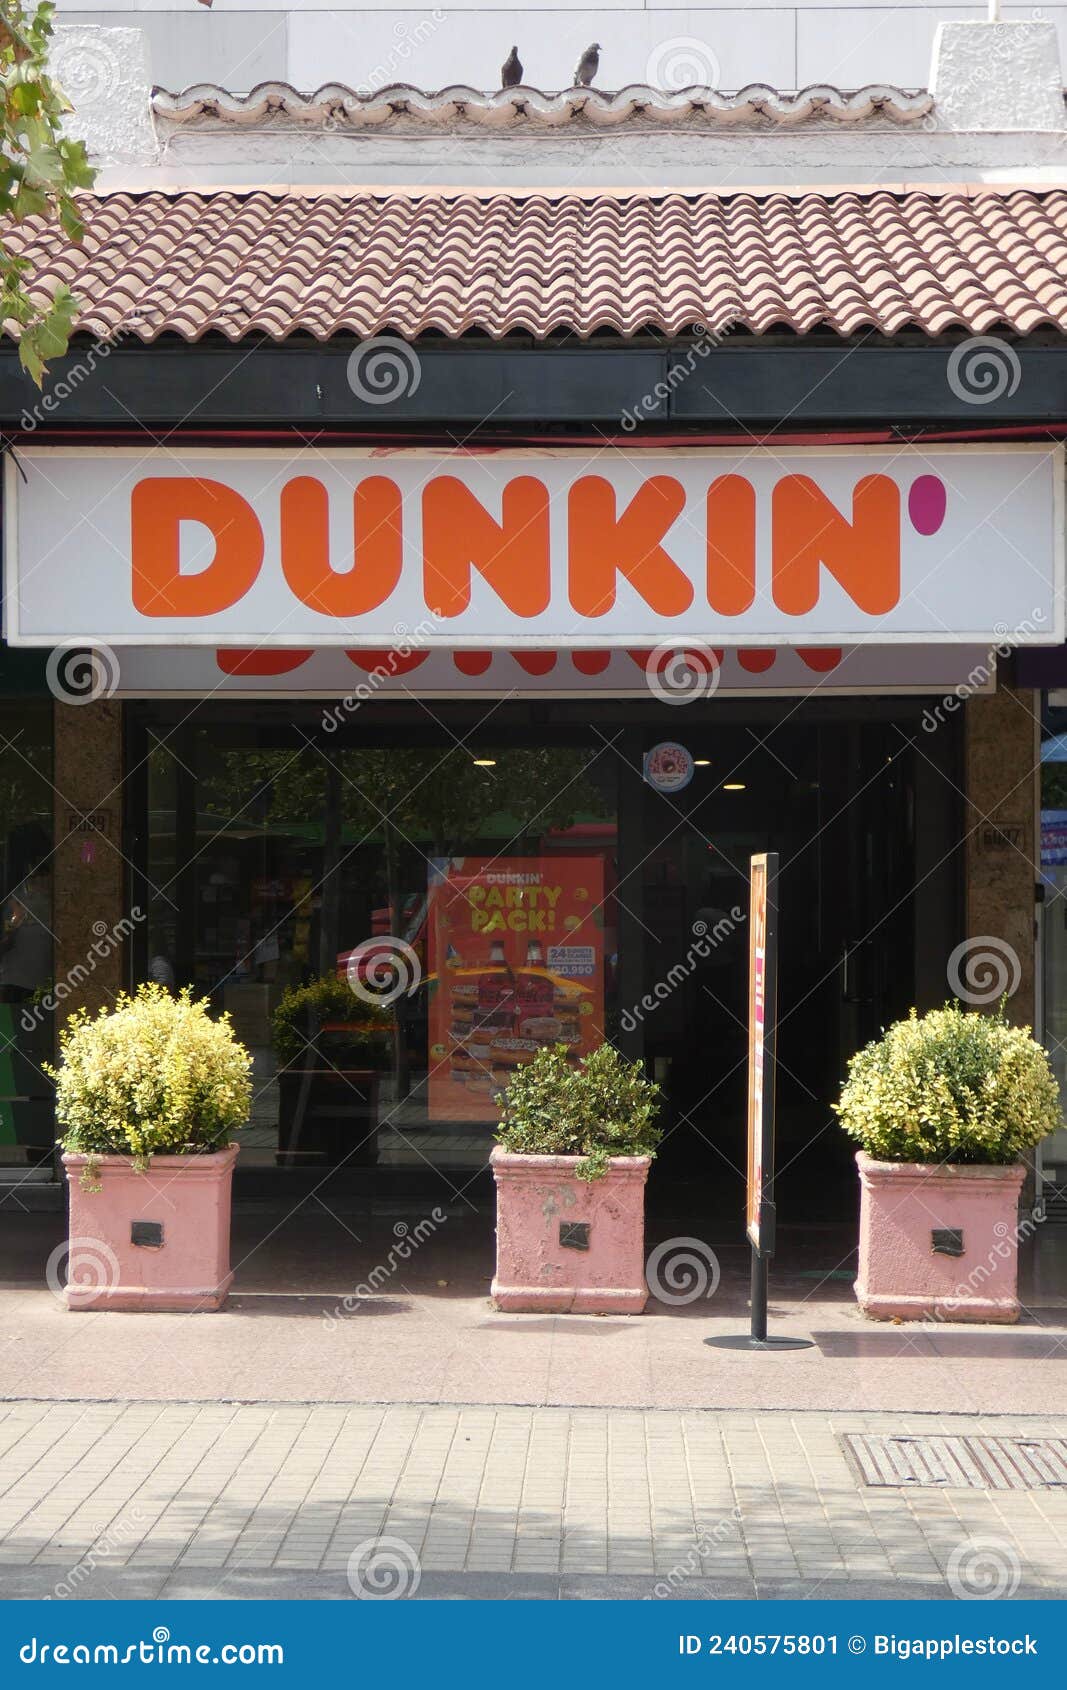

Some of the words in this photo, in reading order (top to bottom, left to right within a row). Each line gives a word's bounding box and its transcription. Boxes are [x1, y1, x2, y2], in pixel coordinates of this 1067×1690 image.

[131, 473, 947, 618] DUNKIN'
[469, 886, 562, 908] PARTY
[472, 909, 556, 932] PACK!
